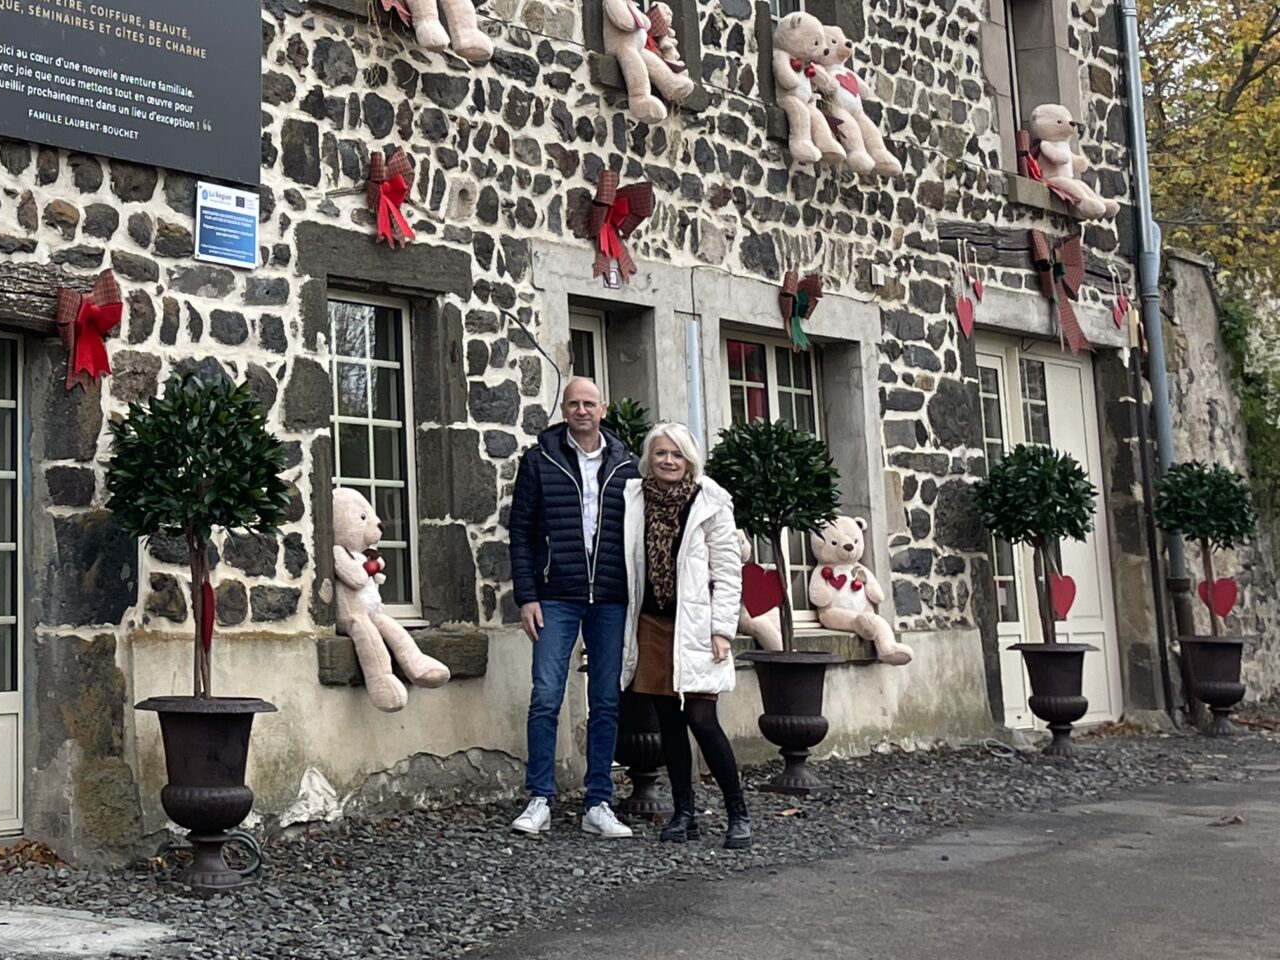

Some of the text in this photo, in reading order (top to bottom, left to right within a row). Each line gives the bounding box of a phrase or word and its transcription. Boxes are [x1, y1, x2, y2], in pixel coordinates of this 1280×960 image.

[28, 3, 95, 31] SÉMINAIRES
[99, 22, 111, 35] ET
[148, 35, 161, 48] DE
[165, 40, 207, 59] CHARME
[90, 4, 146, 29] COIFFURE,
[149, 19, 191, 41] BEAUTÉ,
[15, 64, 33, 77] joie
[34, 71, 52, 81] que
[54, 74, 76, 87] nous
[77, 79, 113, 95] mettons
[114, 87, 133, 100] tout
[134, 92, 145, 102] en
[146, 95, 173, 109] œuvre
[174, 101, 194, 113] pour
[16, 48, 27, 59] au
[29, 52, 53, 64] cœur
[82, 64, 118, 80] nouvelle
[120, 73, 157, 89] aventure
[158, 81, 195, 98] familiale.
[27, 85, 94, 107] prochainement
[95, 99, 117, 113] dans
[118, 105, 129, 115] un
[131, 106, 147, 120] lieu
[28, 108, 139, 140] FAMILLE LAURENT-BOUCHET
